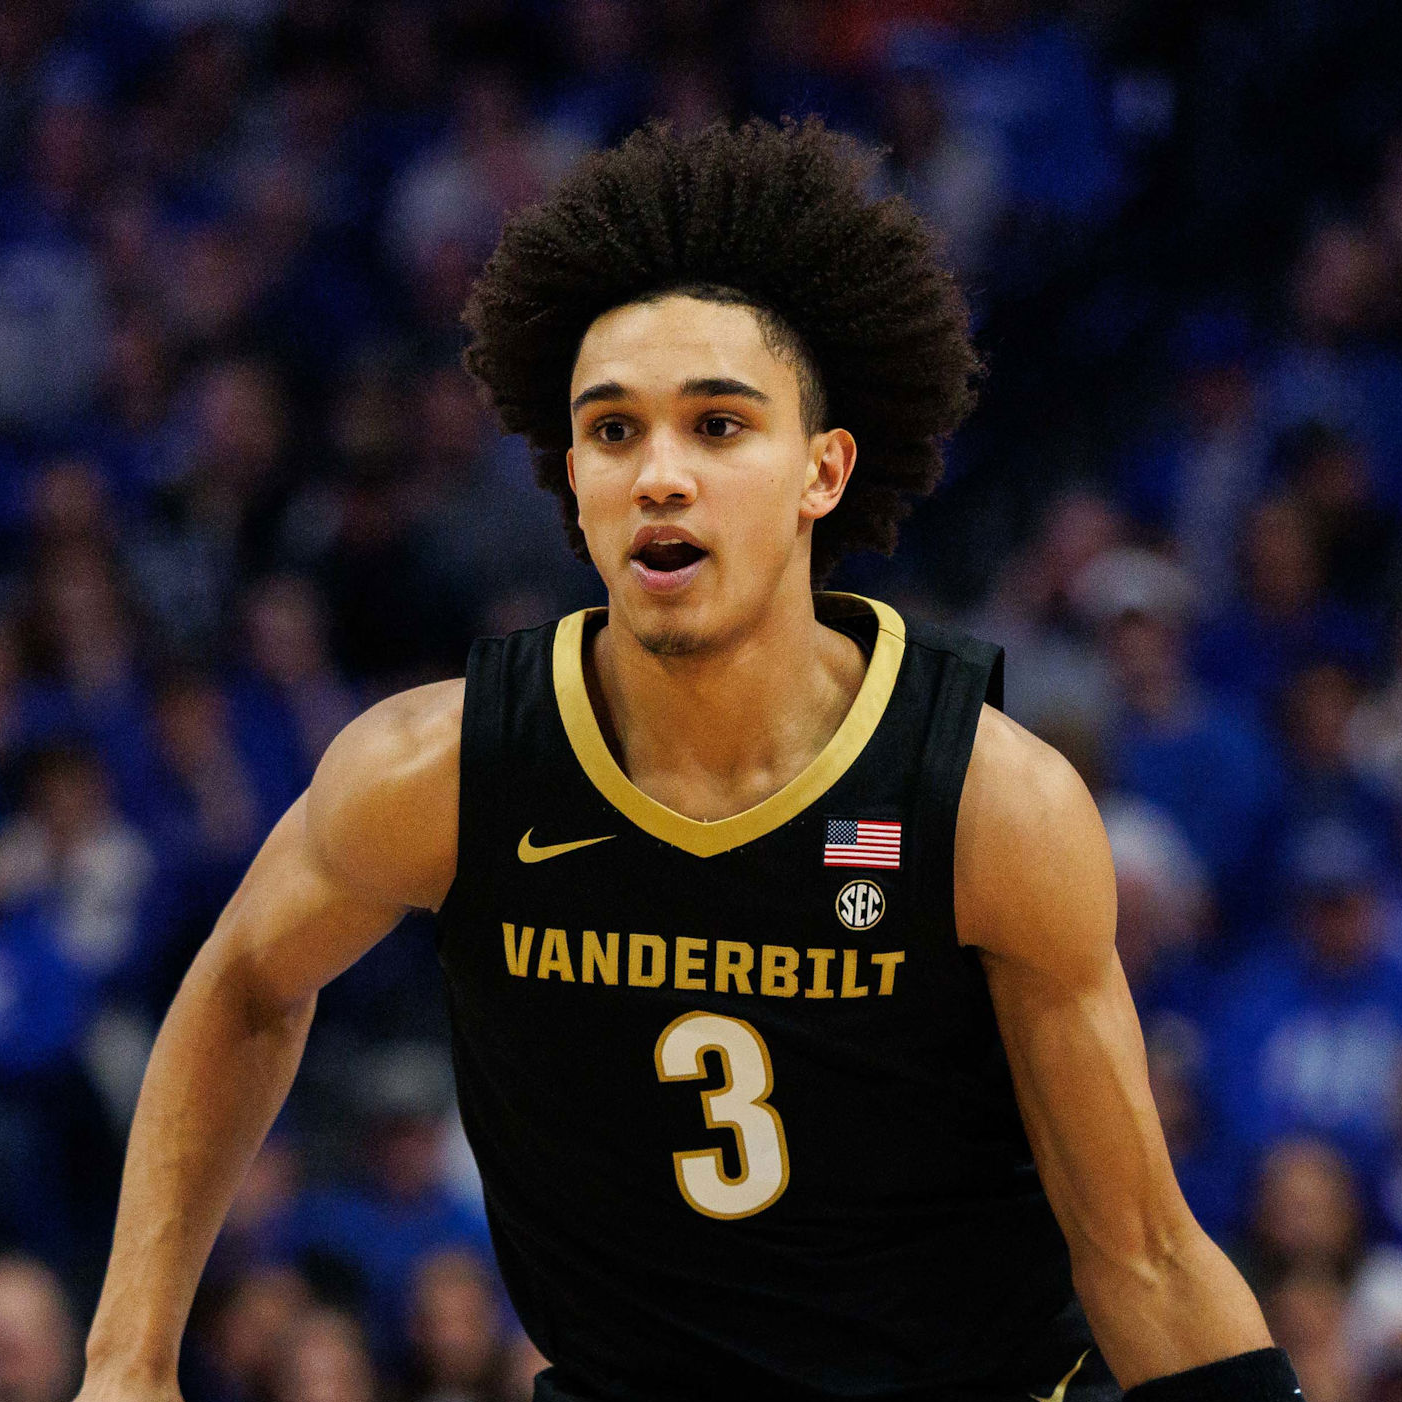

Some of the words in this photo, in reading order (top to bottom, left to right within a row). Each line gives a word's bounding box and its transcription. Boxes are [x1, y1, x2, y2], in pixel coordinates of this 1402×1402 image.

[840, 884, 881, 927] SEC
[502, 922, 905, 999] VANDERBILT
[654, 1009, 790, 1221] 3
